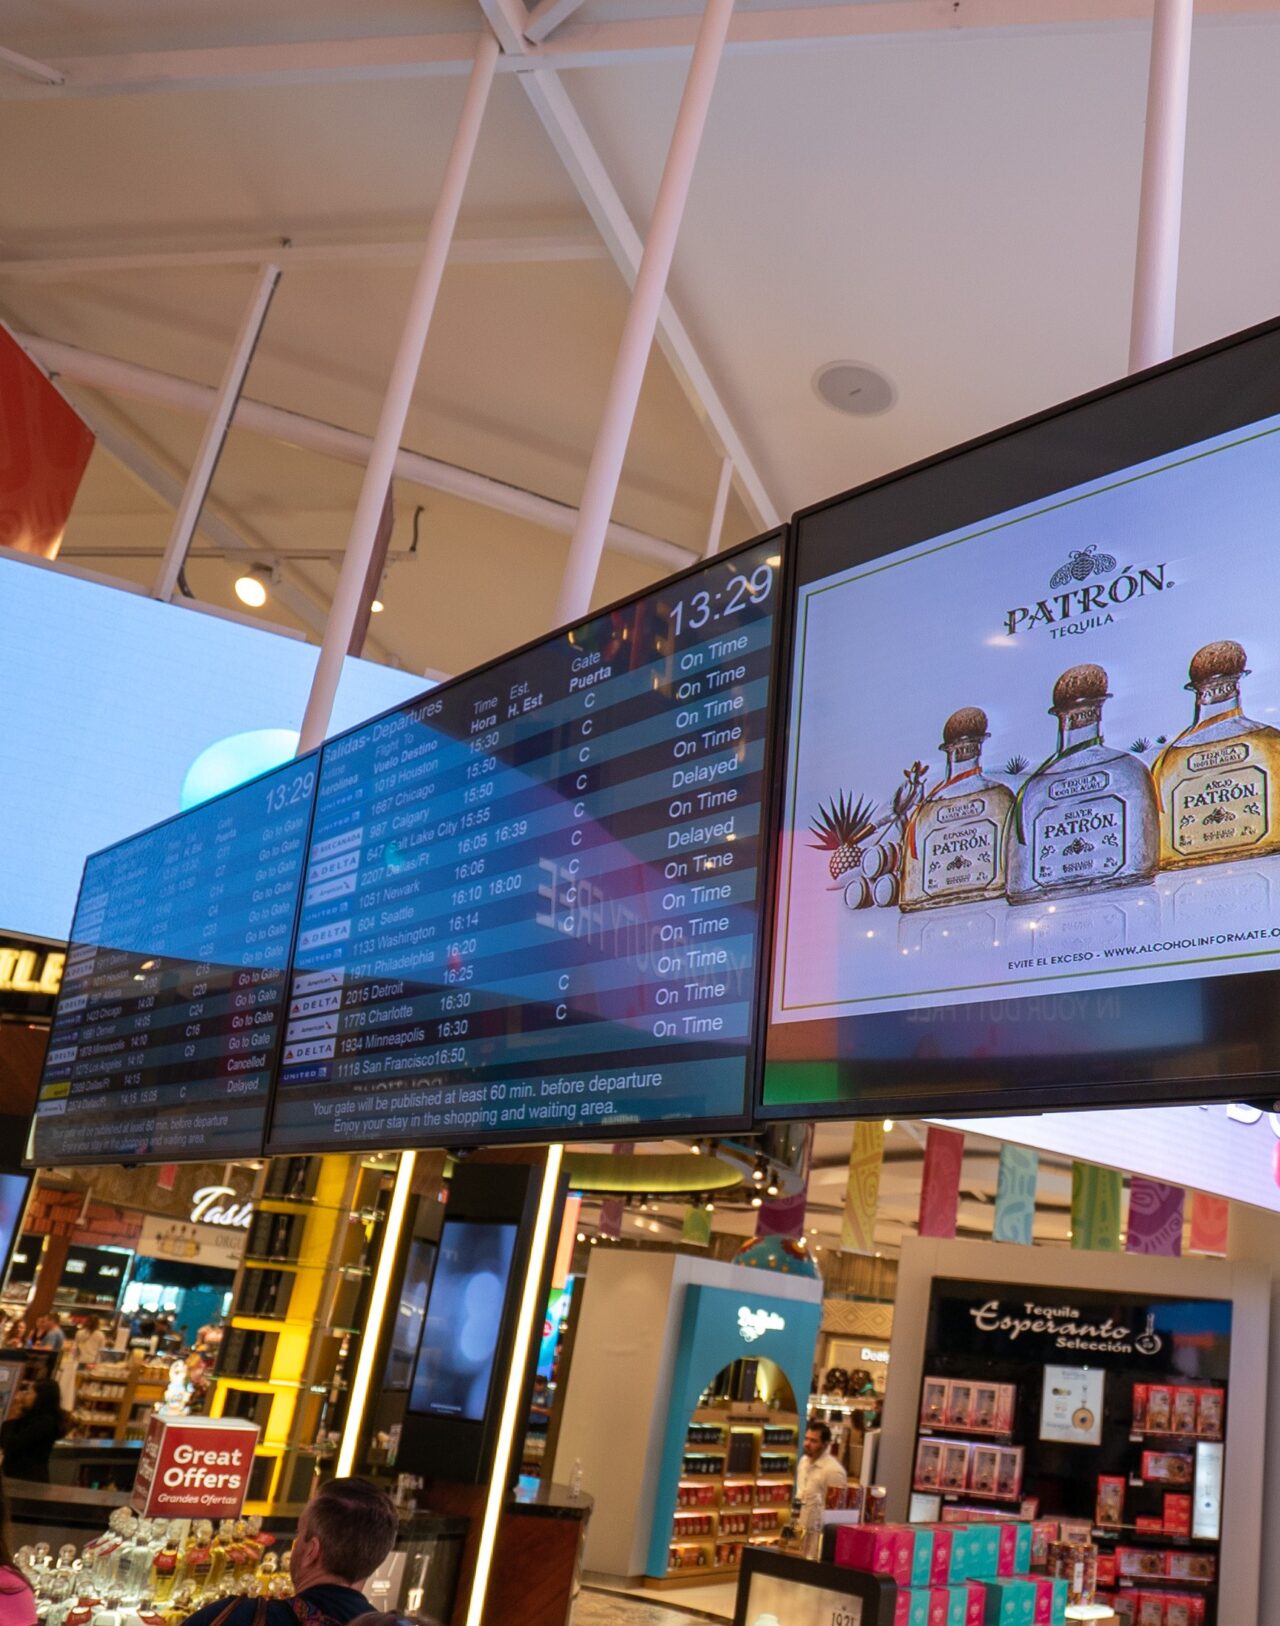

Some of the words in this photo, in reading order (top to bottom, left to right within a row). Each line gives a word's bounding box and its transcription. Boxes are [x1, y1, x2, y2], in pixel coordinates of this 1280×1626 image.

[669, 564, 773, 636] 13:29
[1050, 613, 1114, 640] TEQUILA
[399, 759, 438, 781] Houston
[469, 731, 499, 754] 15:30
[681, 651, 703, 670] On
[708, 635, 748, 659] Time
[401, 740, 438, 758] Destino
[470, 714, 497, 734] Hora
[523, 693, 544, 712] Est
[569, 665, 612, 693] Puerta
[473, 697, 498, 715] Time
[571, 651, 601, 673] Gate
[372, 700, 444, 742] Departures
[395, 783, 435, 807] Chicago
[466, 757, 496, 779] 15:50
[678, 682, 701, 699] On
[706, 665, 746, 689] Time
[266, 771, 315, 814] 13:29
[392, 808, 430, 830] Calgary
[463, 782, 493, 804] 15:50
[676, 712, 698, 728] On
[704, 695, 744, 719] Time
[410, 829, 434, 847] Lake
[437, 821, 458, 838] City
[461, 807, 491, 830] 15:55
[673, 741, 696, 758] On
[701, 726, 742, 750] Time
[458, 833, 488, 854] 16:05
[495, 820, 528, 843] 16:39
[672, 754, 739, 788] Delayed
[383, 880, 420, 900] Newark
[455, 859, 485, 880] 16:06
[669, 801, 692, 818] On
[697, 787, 738, 811] Time
[311, 925, 348, 942] DELTA
[380, 906, 415, 926] Seattle
[451, 885, 482, 906] 16:10
[489, 874, 522, 896] 18:00
[667, 817, 735, 848] Delayed
[378, 925, 435, 951] Washington
[449, 912, 479, 932] 16:14
[664, 861, 687, 879] On
[692, 852, 734, 873] Time
[374, 950, 435, 976] Philadelphia
[446, 938, 477, 957] 16:20
[662, 893, 685, 910] On
[690, 883, 732, 904] Time
[1007, 958, 1035, 971] EVITE
[1036, 956, 1049, 967] EL
[1050, 951, 1095, 966] EXCESO
[303, 996, 338, 1011] DELTA
[371, 981, 404, 1000] Detroit
[443, 965, 474, 985] 16:25
[660, 924, 683, 941] On
[689, 915, 729, 937] Time
[343, 1011, 366, 1029] 1778
[368, 1004, 413, 1024] Charlotte
[440, 992, 471, 1011] 16:30
[657, 956, 680, 973] On
[686, 949, 727, 970] Time
[284, 1070, 317, 1080] UNITED
[338, 1060, 360, 1077] 1118
[363, 1057, 381, 1073] San
[383, 1051, 435, 1070] Francisco
[434, 1047, 466, 1067] 16:50
[653, 1020, 676, 1038] On
[682, 1015, 723, 1034] Time
[296, 1044, 332, 1057] DELTA
[365, 1028, 425, 1050] Minneapolis
[437, 1019, 468, 1038] 16:30
[655, 988, 678, 1005] On
[684, 981, 725, 1002] Time
[227, 1054, 266, 1072] Cancelled
[227, 1078, 259, 1093] Delayed
[313, 1101, 333, 1116] Your
[335, 1100, 357, 1116] gate
[358, 1097, 374, 1112] will
[375, 1096, 388, 1111] be
[390, 1090, 442, 1110] published
[444, 1091, 457, 1105] at
[459, 1088, 488, 1104] least
[490, 1084, 506, 1100] 60
[510, 1081, 537, 1098] min.
[540, 1078, 585, 1096] before
[589, 1072, 663, 1097] departure
[333, 1117, 361, 1134] Enjoy
[362, 1118, 385, 1133] your
[386, 1114, 408, 1131] stay
[410, 1113, 420, 1127] in
[421, 1111, 441, 1126] the
[443, 1106, 497, 1128] shopping
[501, 1104, 525, 1121] and
[528, 1101, 577, 1122] waiting
[580, 1099, 618, 1116] area.
[969, 1300, 1131, 1340] Esperanto
[1024, 1302, 1080, 1320] Tequila
[1055, 1336, 1132, 1354] Selección
[163, 1467, 241, 1489] Offers
[173, 1444, 243, 1467] Great
[157, 1493, 199, 1504] Grandes
[200, 1493, 238, 1506] Ofertas
